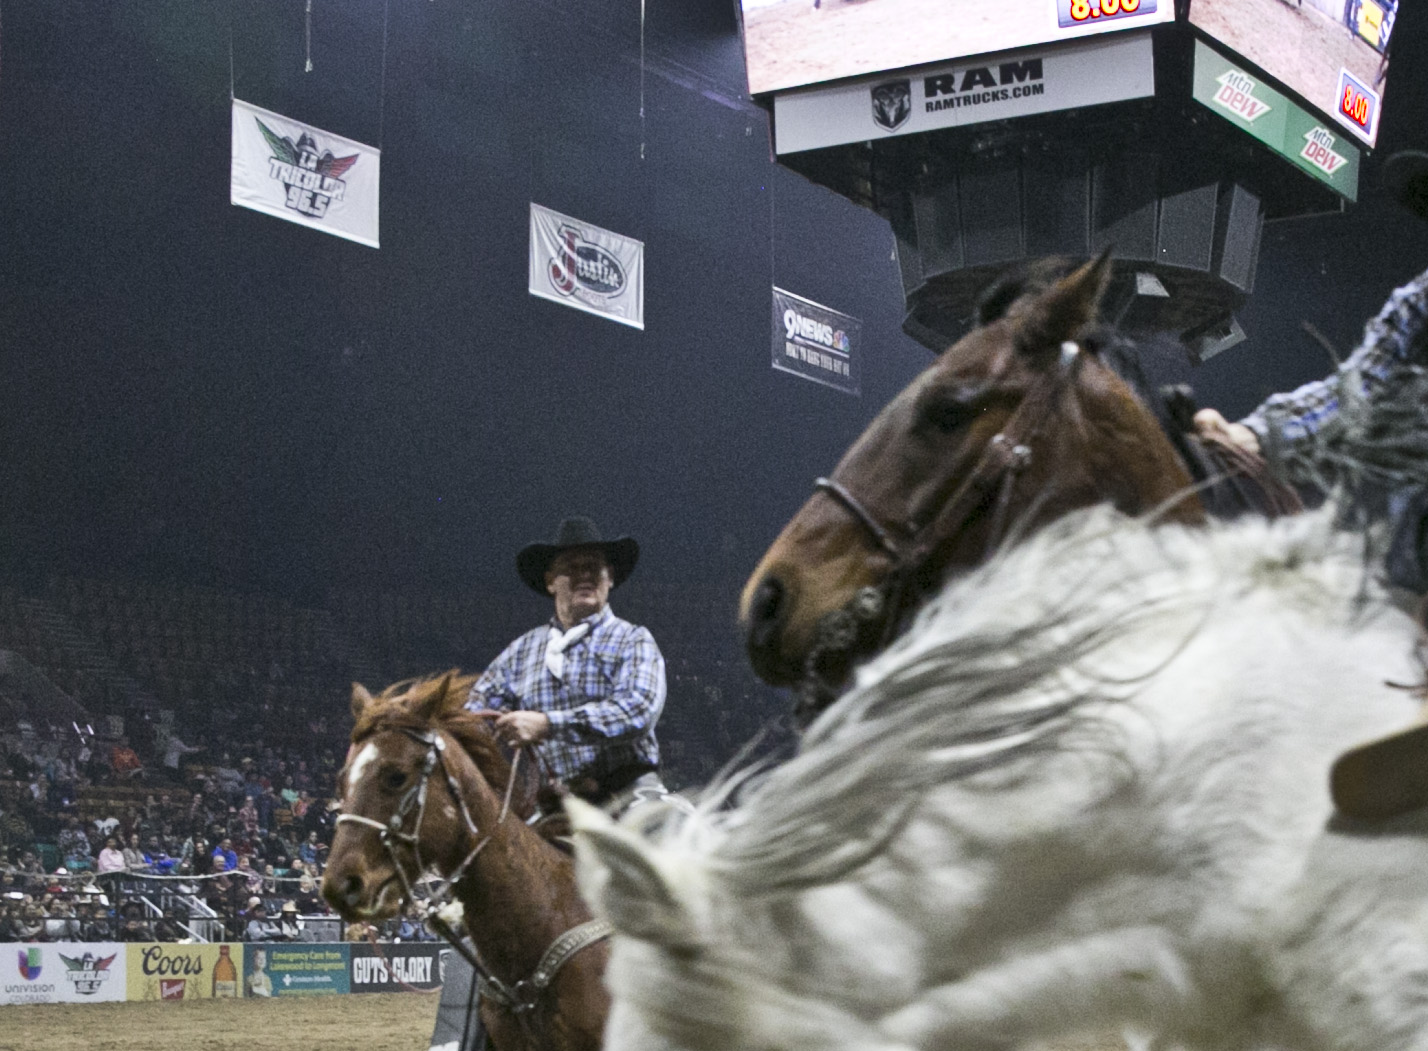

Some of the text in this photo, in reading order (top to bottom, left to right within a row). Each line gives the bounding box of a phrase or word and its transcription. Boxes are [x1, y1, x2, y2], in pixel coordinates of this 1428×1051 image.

[924, 58, 1043, 98] RAM
[925, 84, 1044, 112] RAMTRUCKS.COM
[1342, 84, 1370, 126] 8.00
[299, 151, 319, 172] LA
[269, 157, 346, 201] TRICOLOR
[142, 946, 203, 975] Coors
[353, 957, 433, 983] GUTS GLORY
